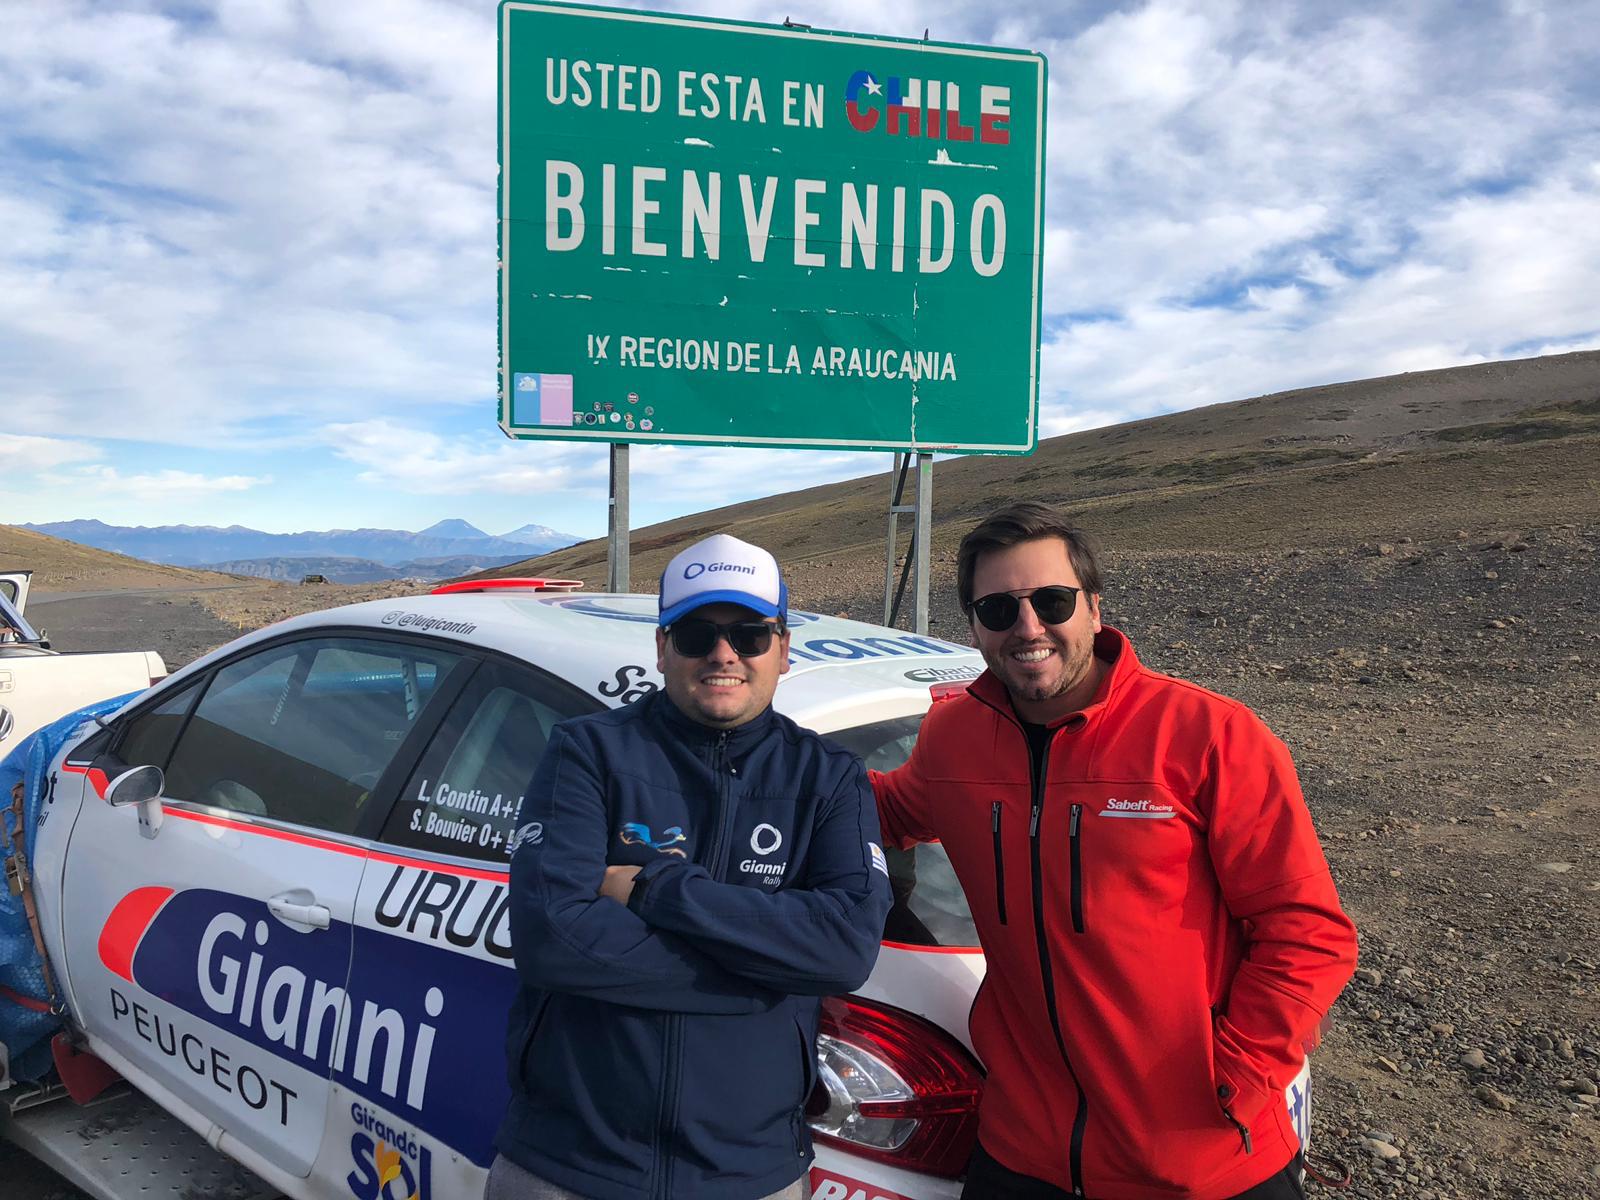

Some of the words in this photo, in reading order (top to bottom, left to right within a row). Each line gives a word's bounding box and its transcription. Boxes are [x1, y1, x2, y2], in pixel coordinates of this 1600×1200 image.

[546, 57, 661, 113] USTED
[679, 70, 767, 124] ESTA
[782, 80, 824, 129] EN
[845, 69, 1011, 145] CHILE
[545, 159, 1007, 277] BIENVENIDO
[587, 334, 611, 365] IX
[620, 336, 720, 371] REGION
[727, 342, 761, 374] DE
[767, 344, 802, 375] LA
[811, 347, 957, 382] ARAUCANIA
[707, 562, 756, 575] Gianni
[397, 612, 478, 635] @luigicontin
[903, 664, 982, 683] Eibach
[417, 780, 431, 802] L.
[436, 783, 489, 814] Contin
[1107, 798, 1149, 811] Sabelt
[1148, 804, 1174, 812] Racing
[410, 808, 422, 832] S.
[425, 811, 478, 844] Bouvier
[739, 859, 787, 875] Gianni
[763, 876, 783, 888] Rally
[198, 911, 444, 1111] Gianni
[110, 987, 298, 1126] PEUGEOT
